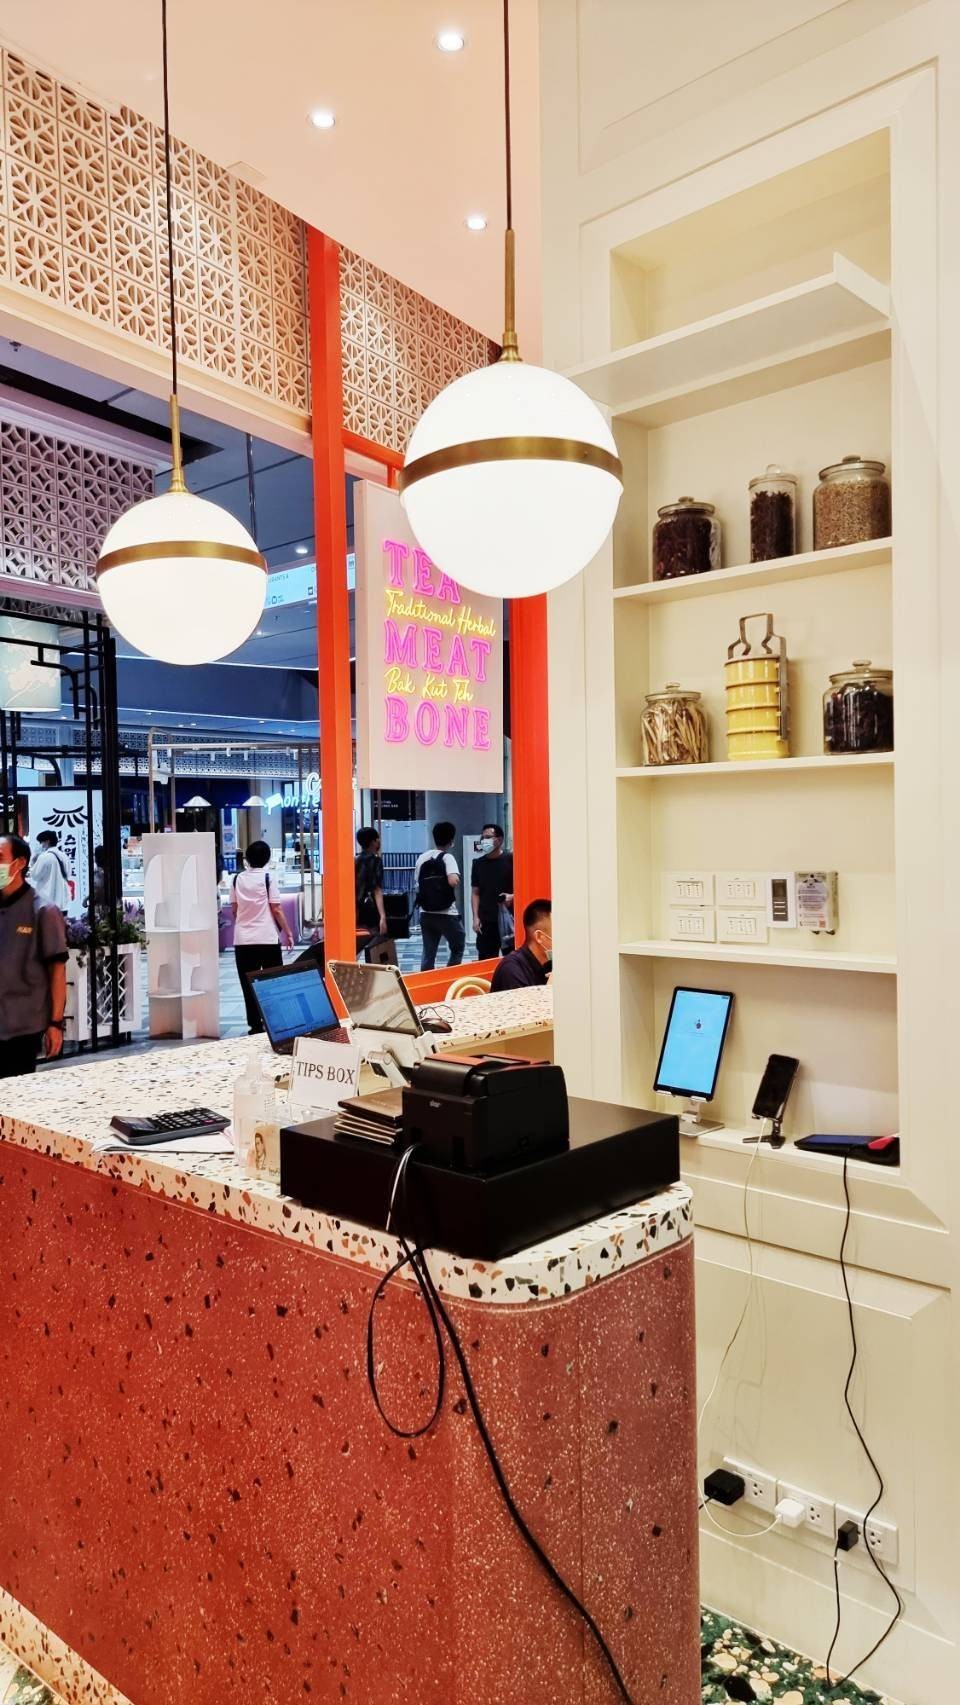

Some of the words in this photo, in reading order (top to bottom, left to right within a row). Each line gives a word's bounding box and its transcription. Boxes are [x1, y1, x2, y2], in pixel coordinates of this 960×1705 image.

[383, 540, 460, 604] TEA
[385, 589, 455, 627] Traditional
[456, 606, 496, 637] Herbal
[384, 619, 491, 682] MEAT
[384, 667, 415, 693] Bak
[420, 671, 447, 699] Kut
[453, 679, 474, 703] Teh
[384, 694, 491, 751] BONE
[297, 1061, 324, 1080] TIPS
[327, 1066, 355, 1085] BOX
